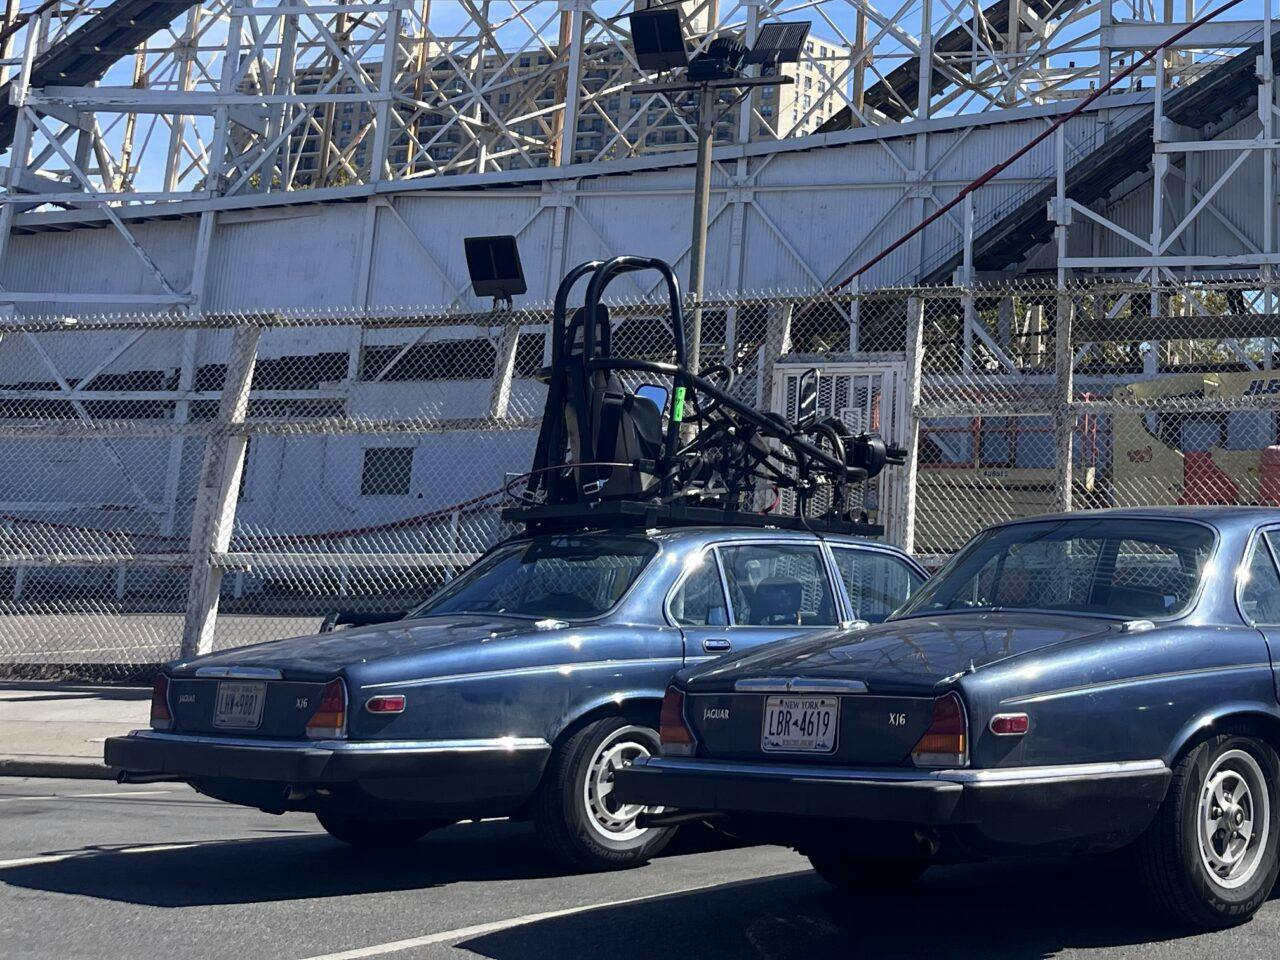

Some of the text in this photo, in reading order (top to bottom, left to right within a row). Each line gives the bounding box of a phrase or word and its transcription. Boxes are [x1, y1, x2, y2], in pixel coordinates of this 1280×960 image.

[784, 700, 819, 710] NEW YORK
[703, 708, 729, 720] JAGUAR
[888, 713, 906, 726] XJ6
